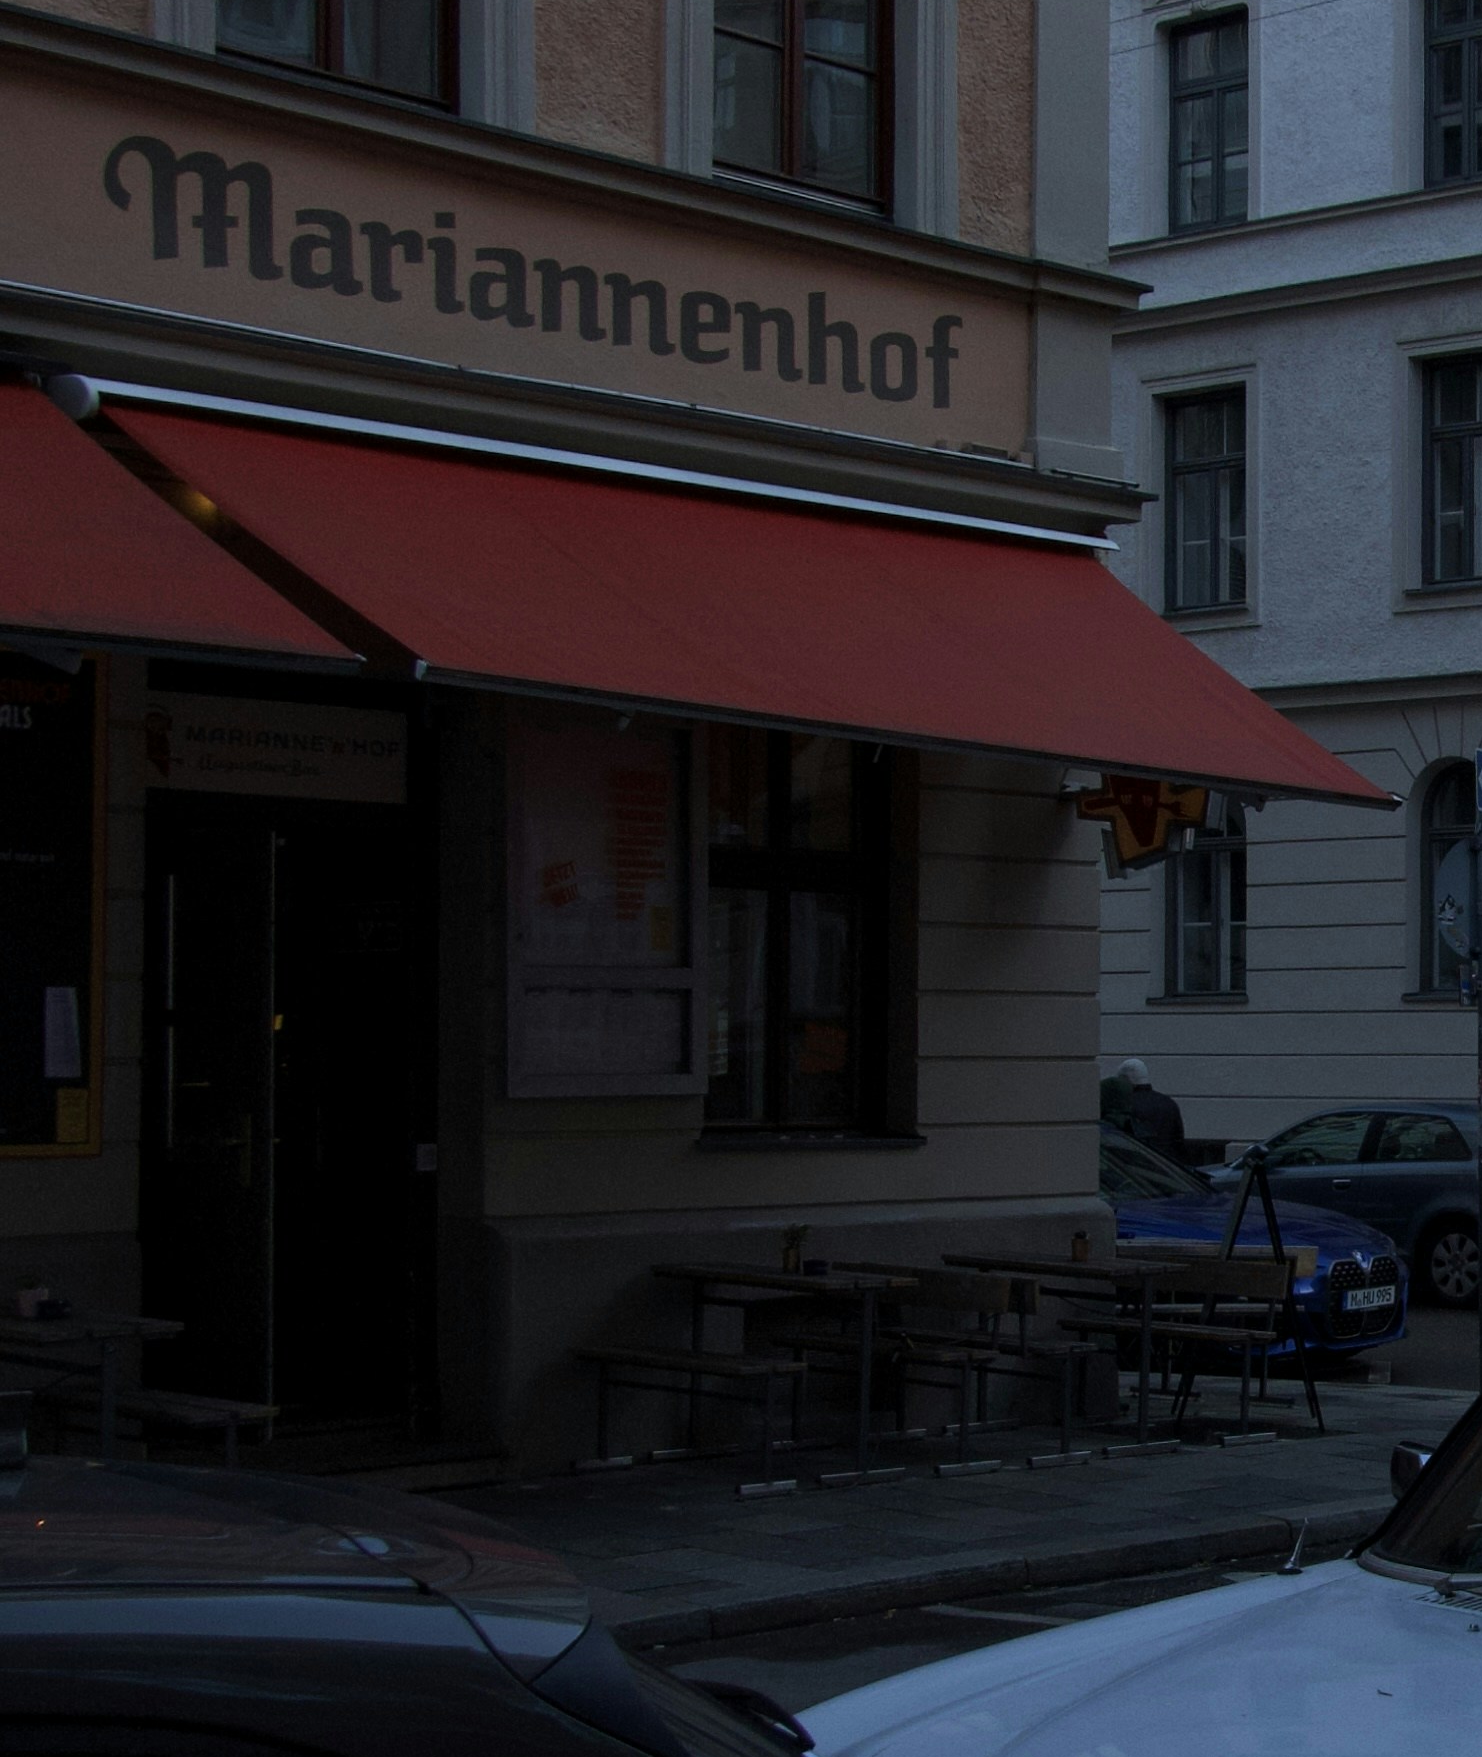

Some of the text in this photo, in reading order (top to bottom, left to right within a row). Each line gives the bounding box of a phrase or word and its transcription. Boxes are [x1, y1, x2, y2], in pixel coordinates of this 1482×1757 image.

[103, 135, 964, 409] Mariannenhof
[1350, 1287, 1392, 1307] M HU 995
